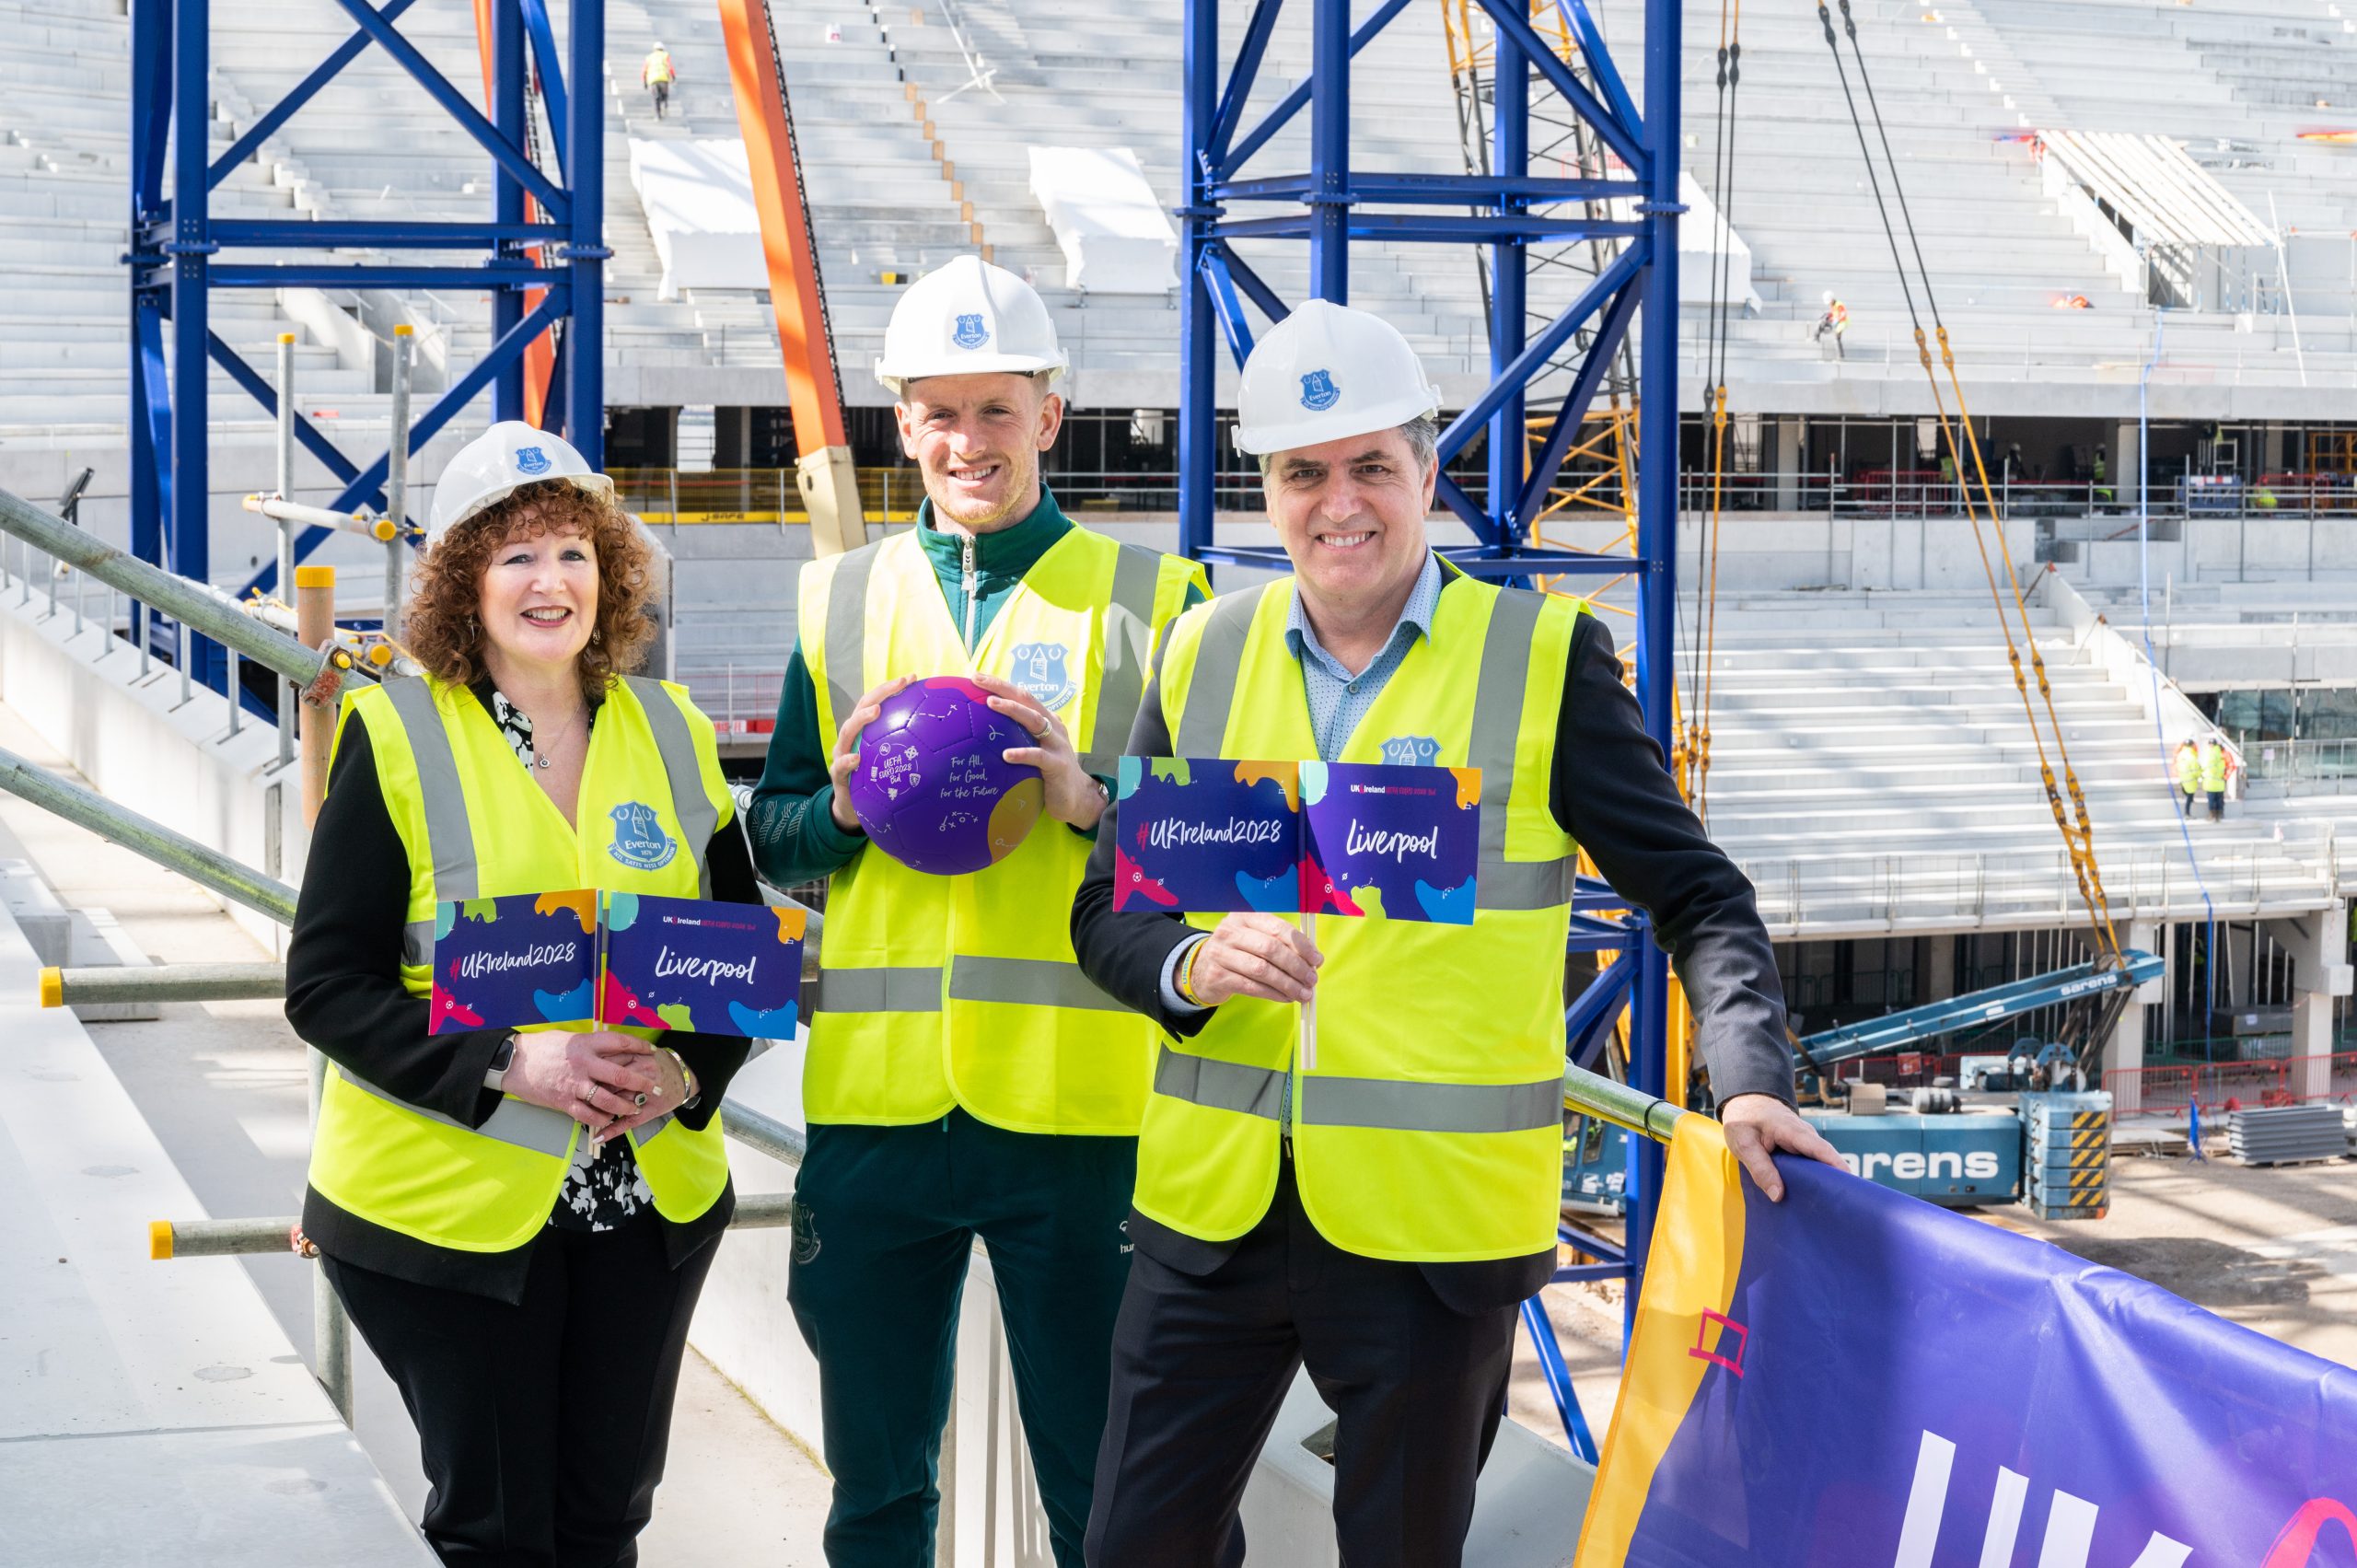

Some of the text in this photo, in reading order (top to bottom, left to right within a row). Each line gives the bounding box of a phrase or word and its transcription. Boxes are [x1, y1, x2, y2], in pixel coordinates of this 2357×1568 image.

[884, 754, 902, 769] UEFA
[951, 756, 966, 768] For
[889, 772, 902, 784] Bid
[949, 772, 961, 783] for
[940, 785, 999, 799] for the Future
[1136, 816, 1283, 852] #UKIreland2028
[1346, 818, 1438, 864] Liverpool
[624, 840, 661, 850] Everton
[449, 941, 576, 983] #UKIreland2028
[655, 945, 757, 987] Liverpool
[2061, 974, 2118, 996] sarens
